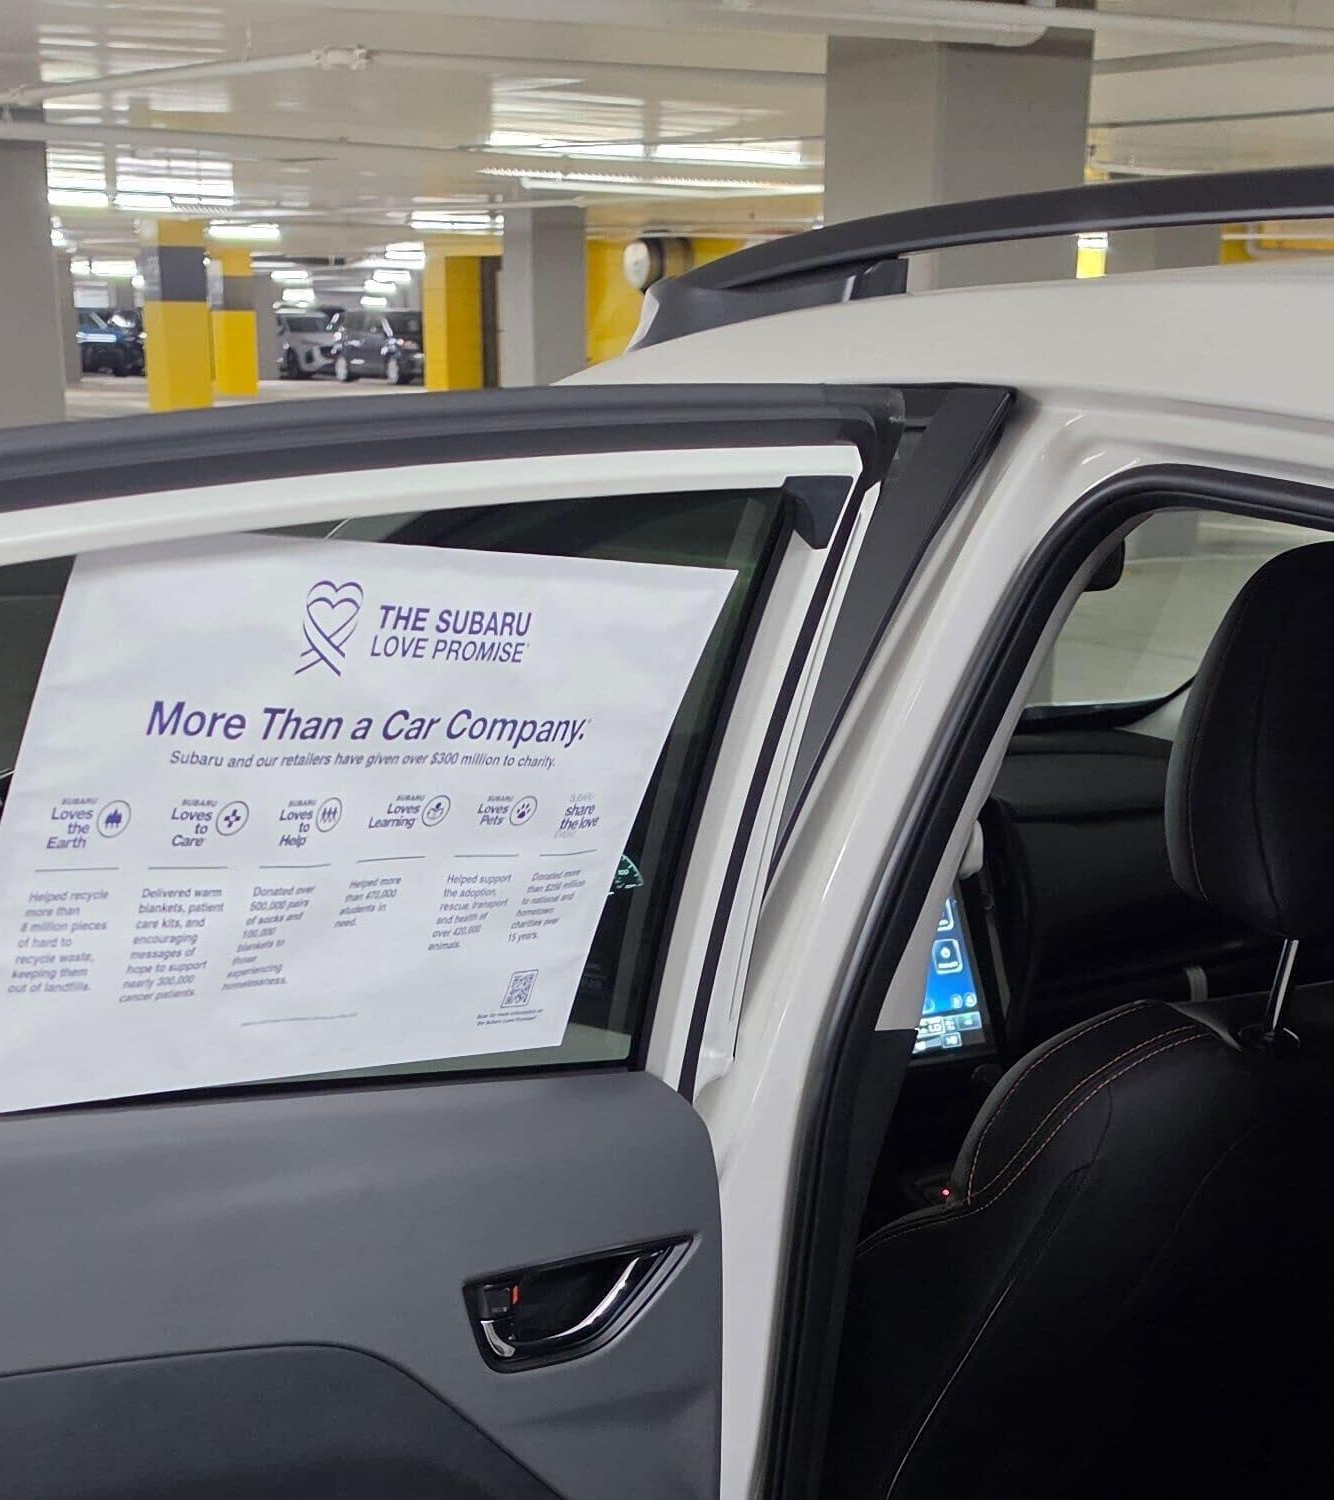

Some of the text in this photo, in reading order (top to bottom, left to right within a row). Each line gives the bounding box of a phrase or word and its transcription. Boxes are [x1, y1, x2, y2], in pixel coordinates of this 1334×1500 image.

[380, 605, 531, 636] THE SUBARU
[371, 636, 525, 663] LOVE PROMISE
[146, 701, 585, 748] More Than a Car Company.
[170, 750, 555, 770] Subaru and our retailers have given over $300 million to charity.
[51, 808, 93, 820] Loves
[171, 808, 213, 820] Loves
[387, 803, 421, 814] Loves
[477, 803, 509, 814] Loves
[565, 803, 595, 816] share
[279, 810, 313, 821] Loves
[480, 815, 504, 825] Pets
[67, 822, 90, 834] the
[299, 822, 310, 832] to
[369, 816, 416, 829] Learning
[560, 817, 599, 830] the love
[195, 823, 208, 834] to
[47, 835, 87, 849] Earth
[172, 835, 204, 847] Care
[279, 834, 306, 848] Help
[349, 878, 379, 889] Helped
[447, 874, 512, 885] Helped support
[28, 888, 108, 903] Helped recycle
[142, 888, 222, 898] Delivered warm
[253, 886, 316, 897] Donated over
[443, 889, 457, 897] the
[139, 903, 224, 914] blankets, patient
[472, 898, 508, 909] transport
[136, 921, 159, 929] care
[186, 917, 206, 928] and
[246, 915, 257, 926] of
[436, 916, 453, 924] and
[71, 921, 107, 933] pieces
[133, 934, 198, 945] encouraging
[432, 930, 451, 938] over
[18, 937, 29, 948] of
[61, 938, 72, 947] to
[130, 947, 196, 960] messages of
[126, 964, 152, 975] hope
[169, 960, 207, 972] support
[8, 984, 27, 992] out
